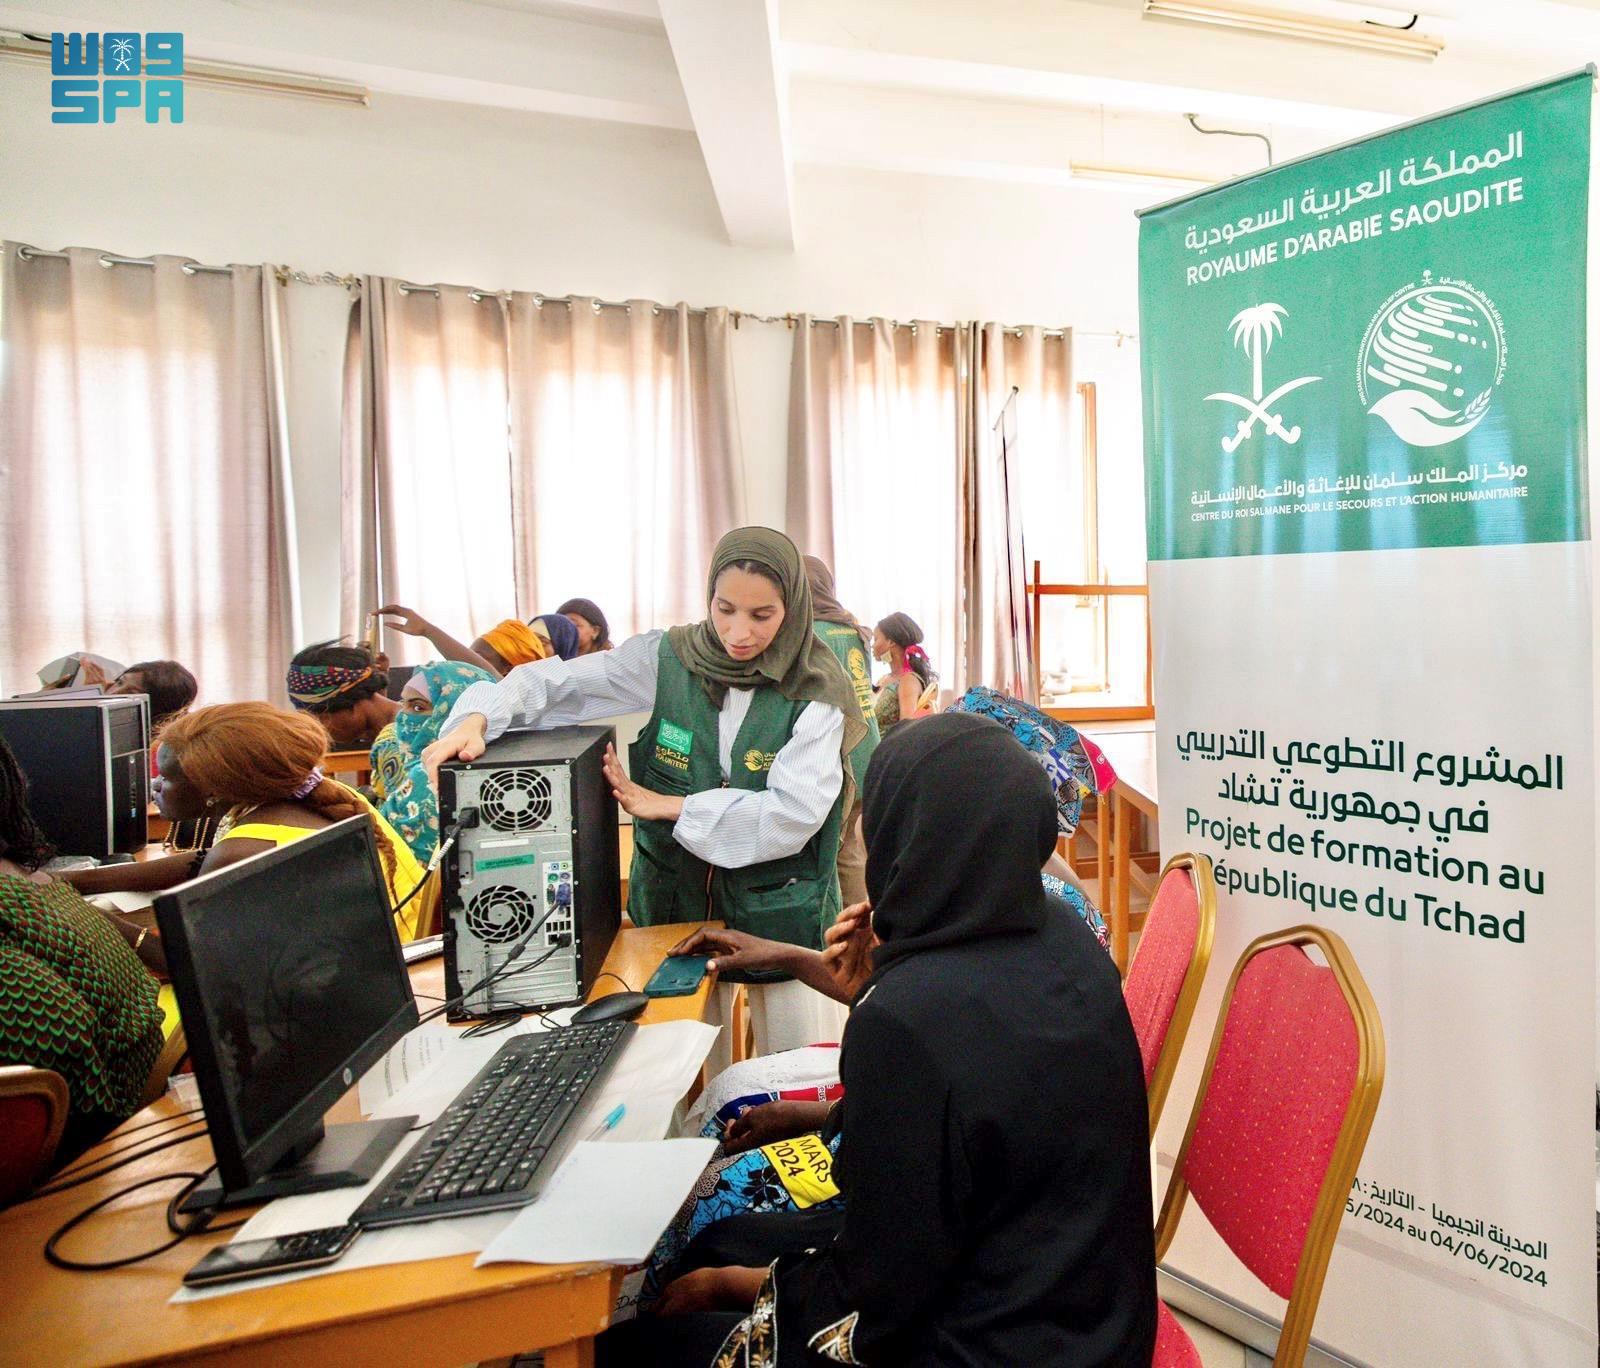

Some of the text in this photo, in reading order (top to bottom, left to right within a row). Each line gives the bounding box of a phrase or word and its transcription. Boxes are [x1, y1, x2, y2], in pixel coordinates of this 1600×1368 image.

[1184, 131, 1524, 255] المملكة العربية السعودية
[1187, 177, 1523, 285] ROYAUME D'ARABIE SAOUDITE
[1191, 461, 1528, 507] مركز الملك سلمان للإغاثة والأعمال الإنسانية
[1191, 486, 1528, 522] CENTRE DU ROI SALMANE POUR LE SECOURS ET L'ACTION HUMANITAIRE
[1176, 728, 1563, 791] المشروع التطوعي التدريبي
[1218, 772, 1490, 843] في جمهورية تشاد
[1186, 808, 1545, 895] Projet de formation au
[1206, 855, 1526, 944] épublique du Tchad
[771, 1142, 805, 1177] 2024
[799, 1138, 832, 1183] MARS
[1346, 1197, 1548, 1288] 5/2024 au 04/06/2024
[1488, 1224, 1547, 1260] المدينة
